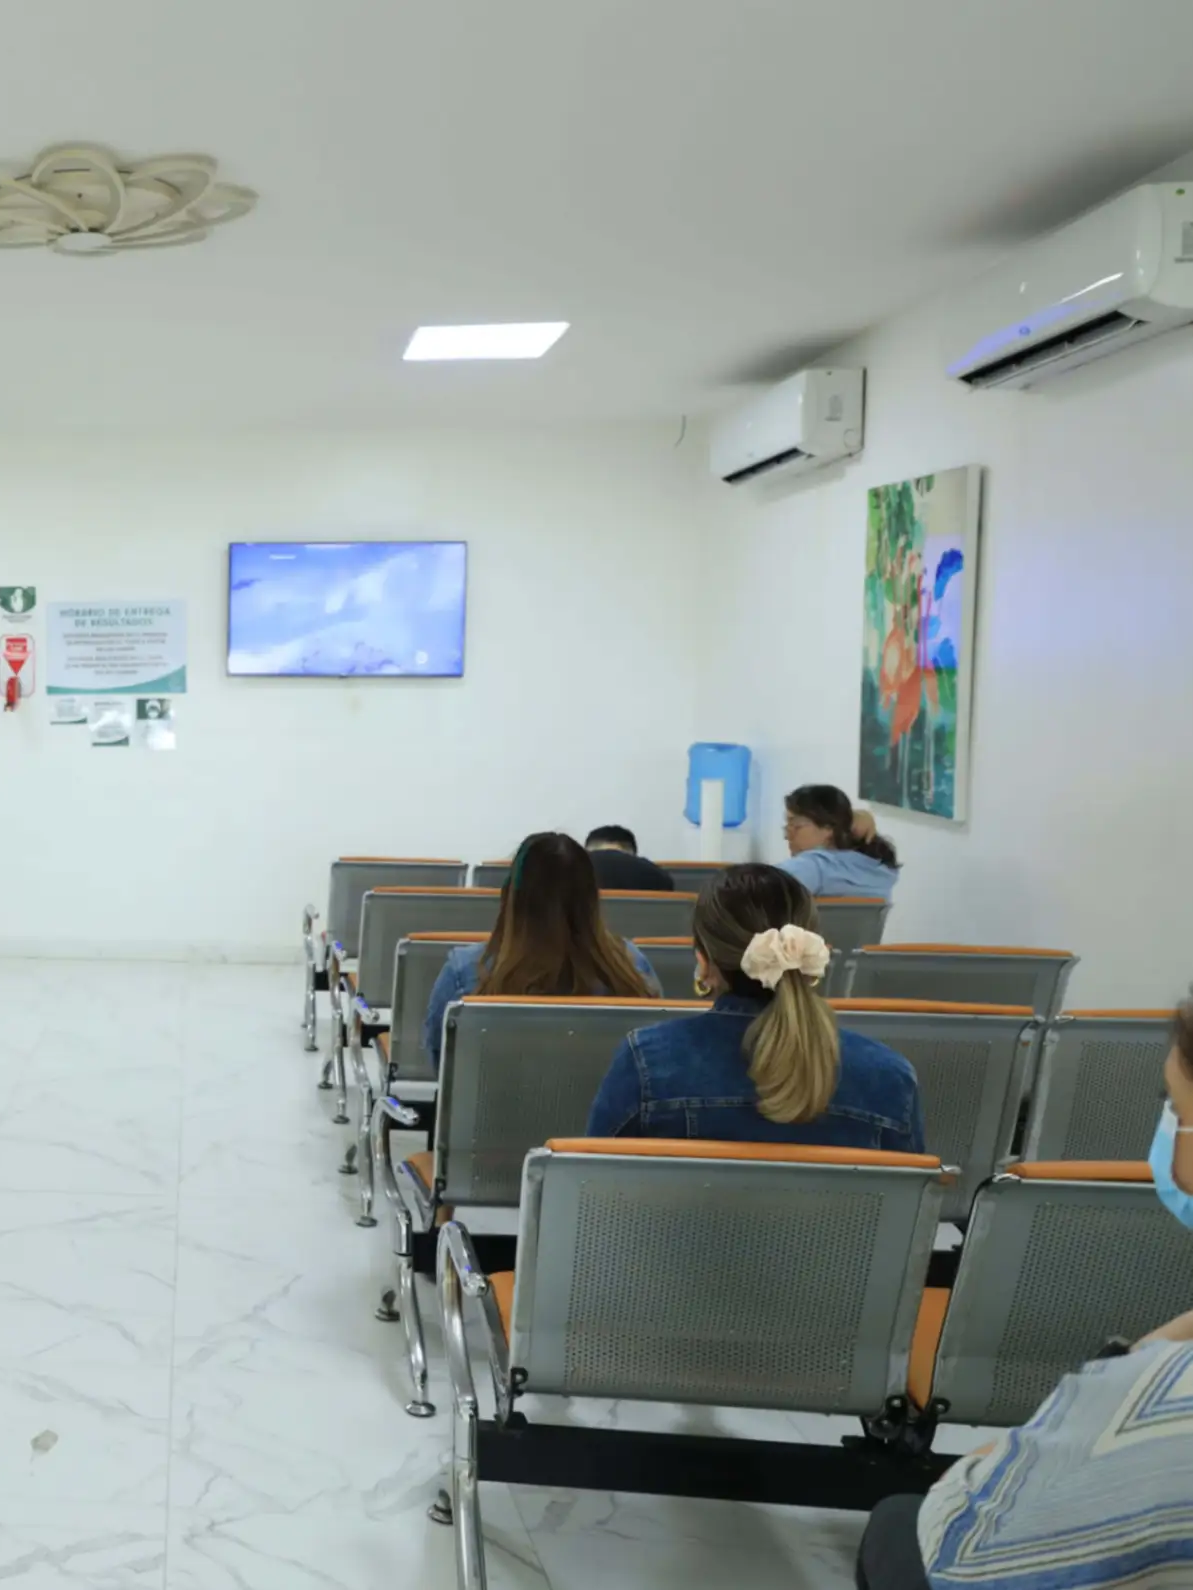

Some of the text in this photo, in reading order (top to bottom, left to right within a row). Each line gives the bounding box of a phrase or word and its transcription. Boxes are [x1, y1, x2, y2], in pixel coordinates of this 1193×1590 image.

[108, 608, 121, 616] DE
[124, 607, 171, 616] ENTREGA
[74, 619, 86, 628] DE
